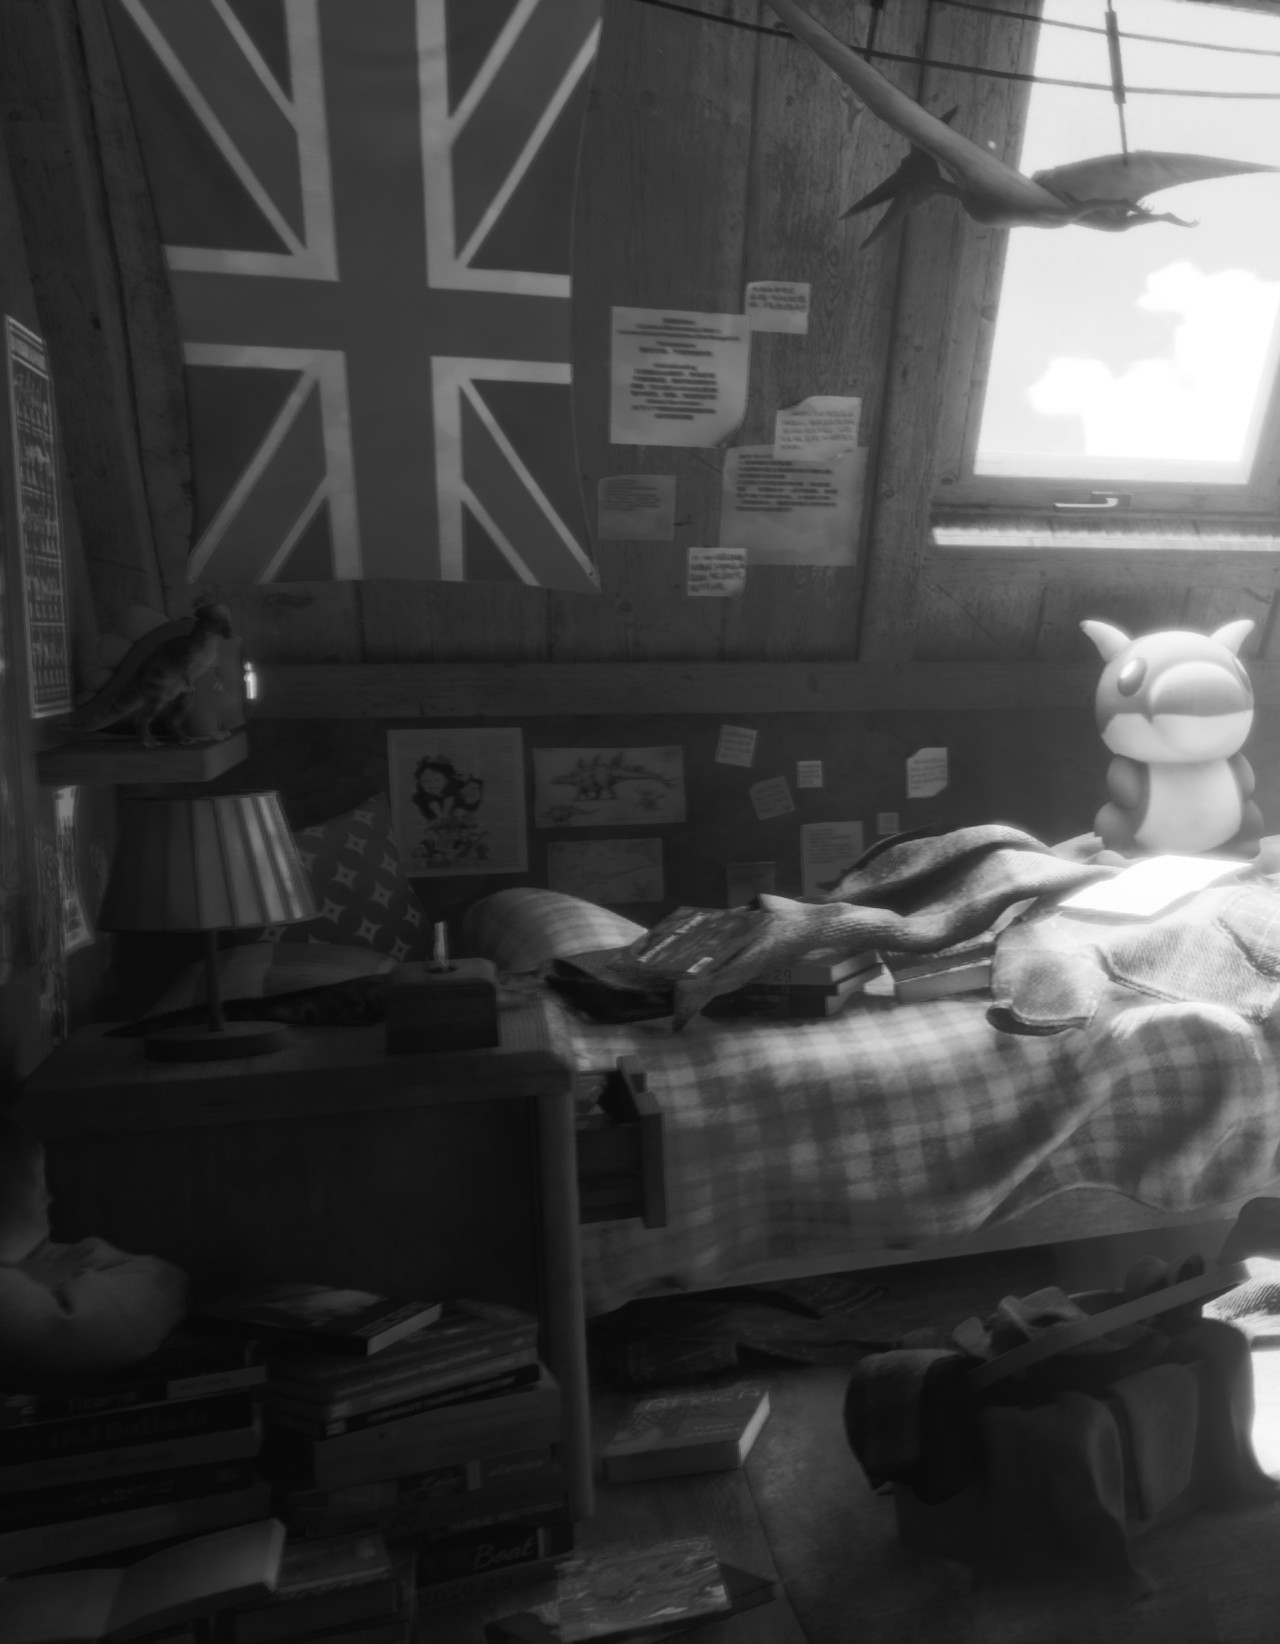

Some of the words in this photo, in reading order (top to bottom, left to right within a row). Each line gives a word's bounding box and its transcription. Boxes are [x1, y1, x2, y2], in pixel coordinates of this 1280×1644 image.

[774, 969, 791, 982] 29
[418, 1583, 477, 1606] UDIO
[483, 1575, 514, 1592] 29
